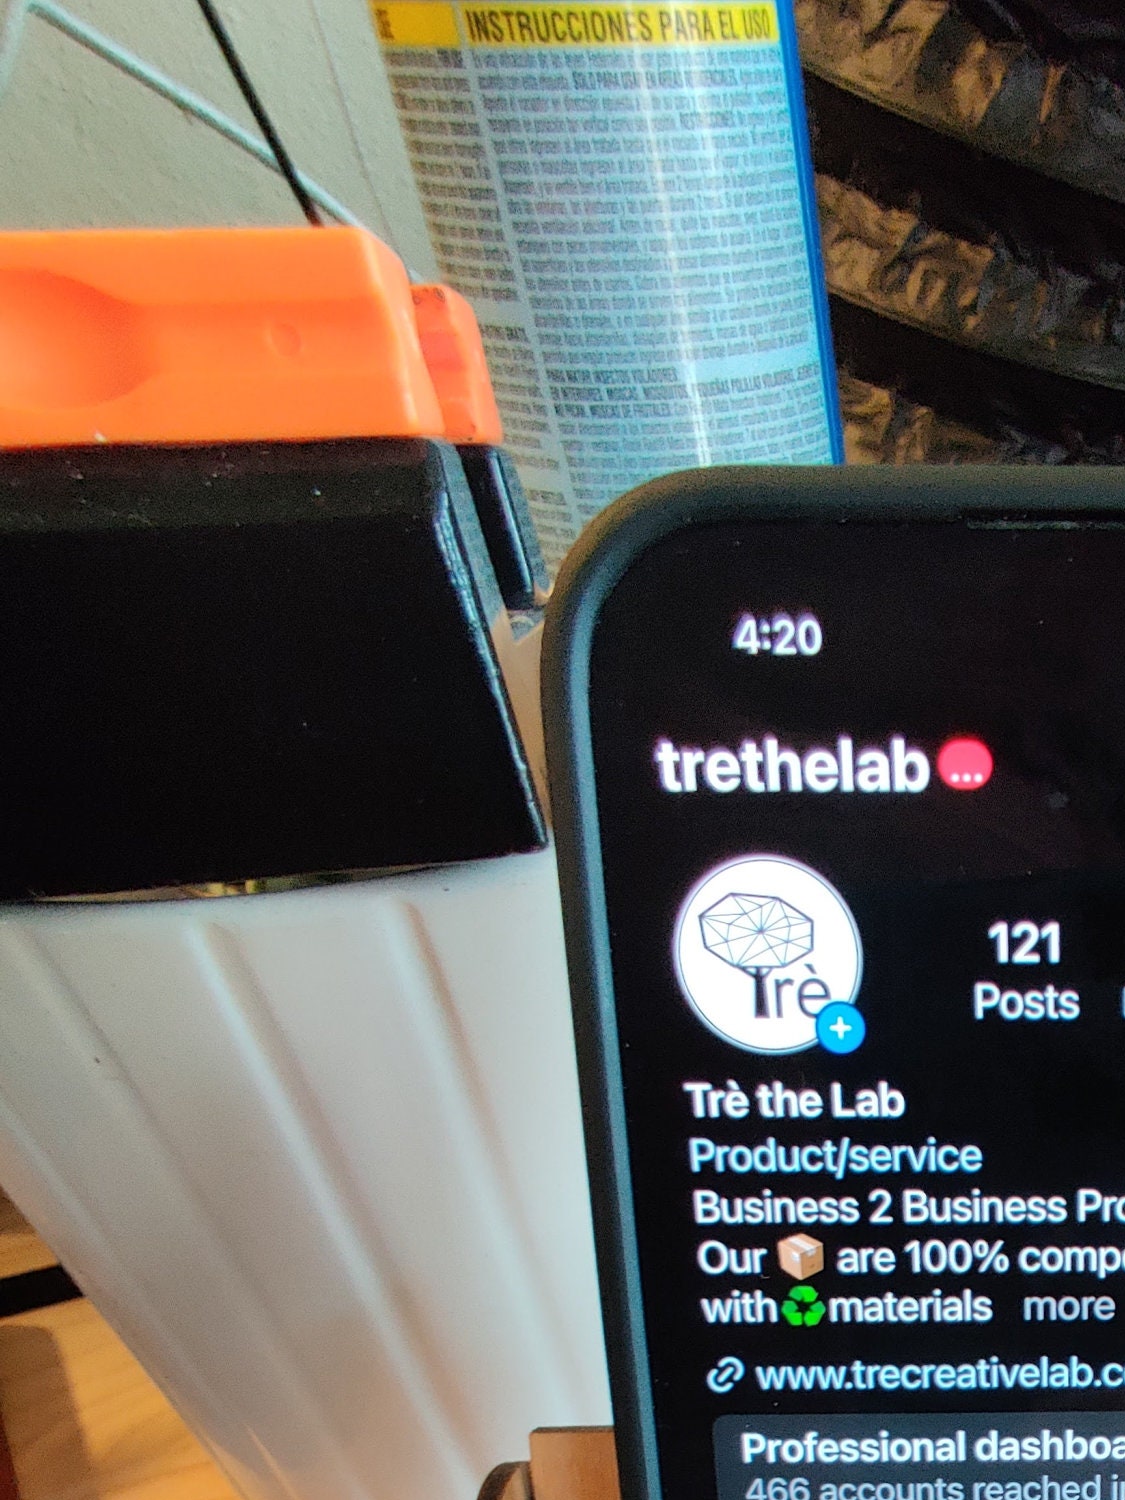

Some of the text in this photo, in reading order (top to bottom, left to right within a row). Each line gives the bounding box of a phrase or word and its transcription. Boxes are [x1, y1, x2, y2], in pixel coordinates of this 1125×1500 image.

[465, 8, 770, 43] INSTRUCCIONES PARA EL USO
[733, 612, 823, 656] 4:20
[656, 736, 931, 793] trethelab
[988, 921, 1061, 964] 121
[973, 982, 1080, 1021] Posts
[682, 1079, 906, 1119] Trè the Lab
[688, 1136, 983, 1181] Product/service
[692, 1188, 861, 1225] Business
[867, 1188, 894, 1225] 2
[902, 1188, 1067, 1225] Business
[697, 1239, 768, 1276] Our
[836, 1246, 896, 1275] are
[904, 1239, 1010, 1275] 100%
[701, 1288, 1116, 1324] with materials more
[740, 1429, 967, 1465] Professional
